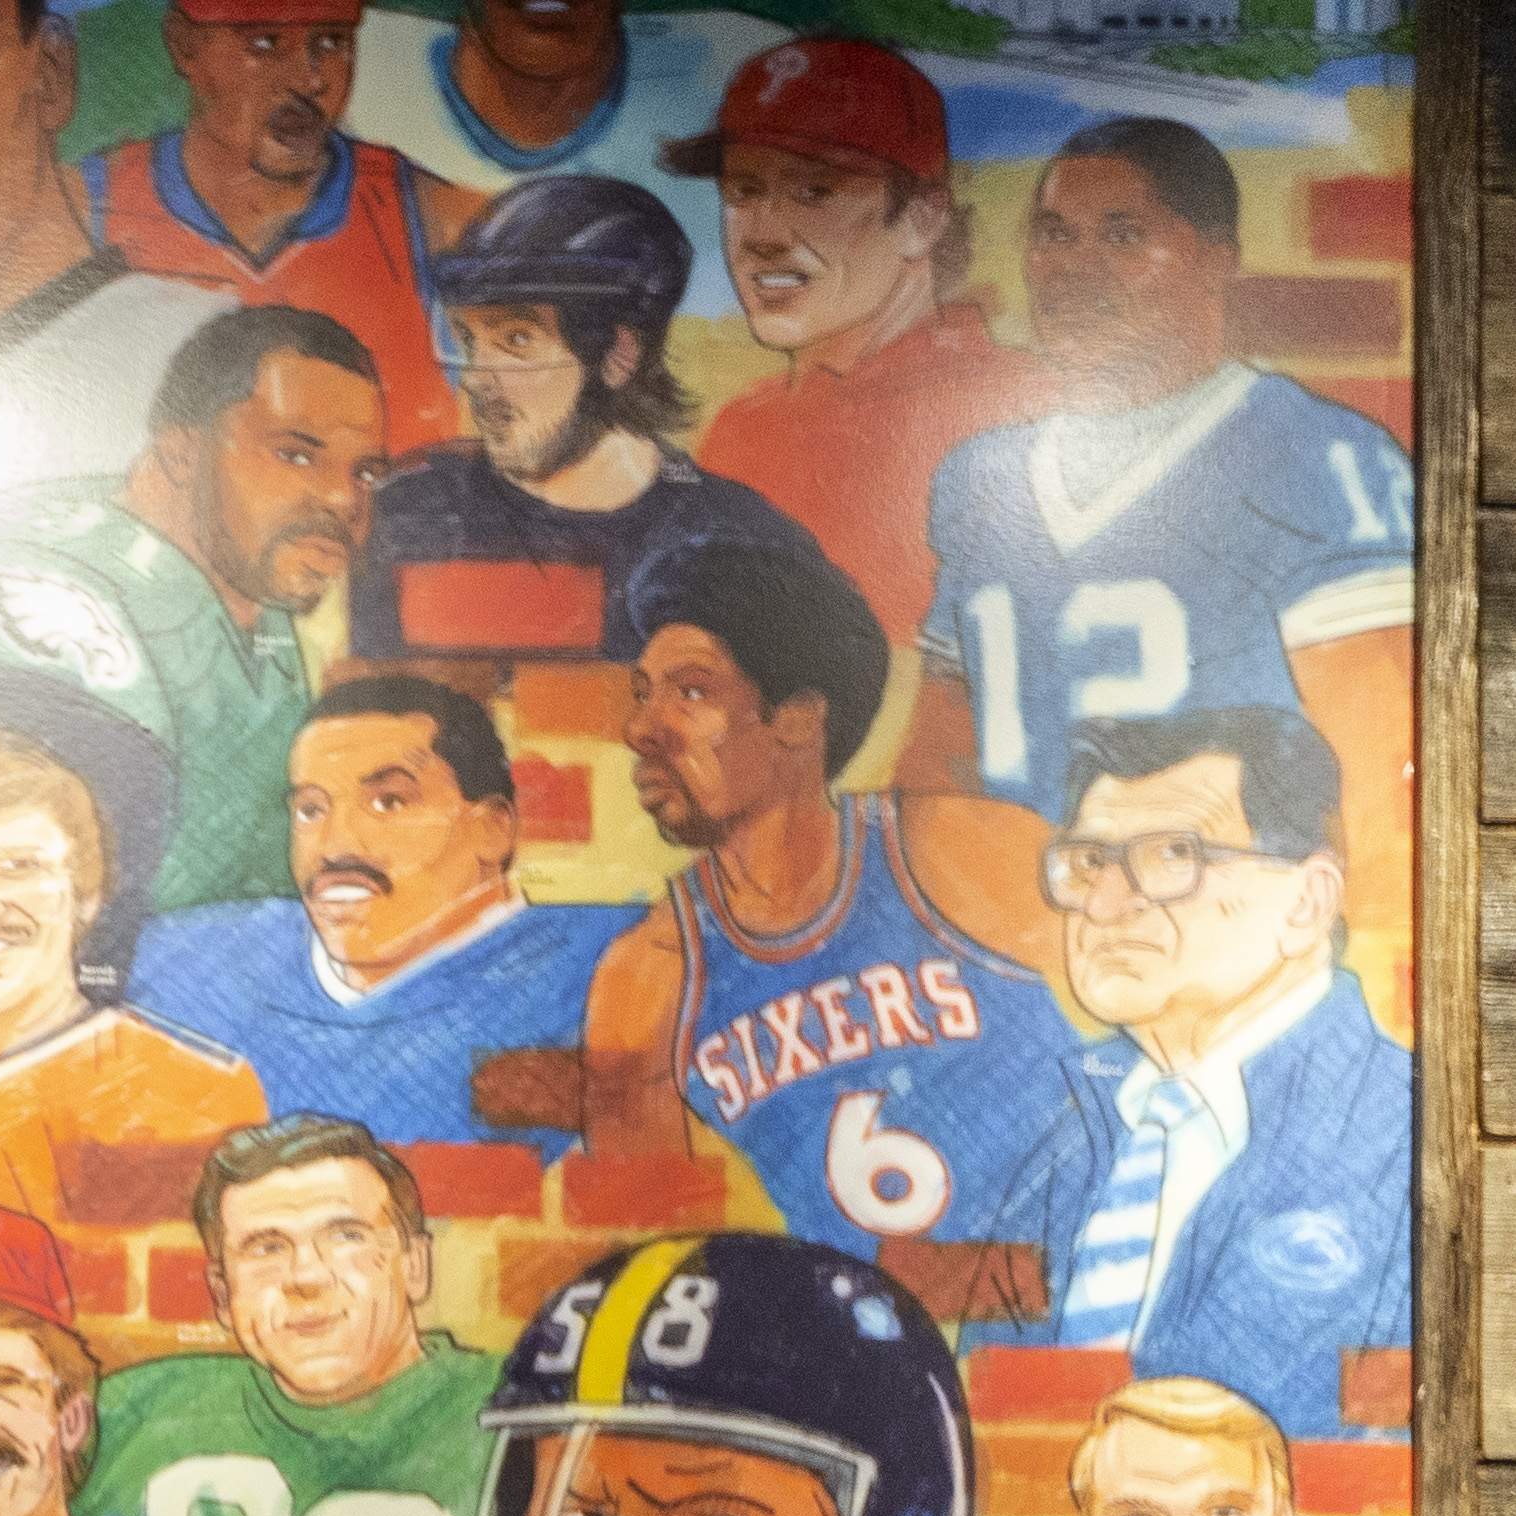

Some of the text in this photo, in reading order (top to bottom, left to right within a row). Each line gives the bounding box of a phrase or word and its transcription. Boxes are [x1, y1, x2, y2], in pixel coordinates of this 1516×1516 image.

[694, 957, 981, 1126] SIXERS
[824, 1089, 953, 1237] 6
[534, 1274, 719, 1372] 58
